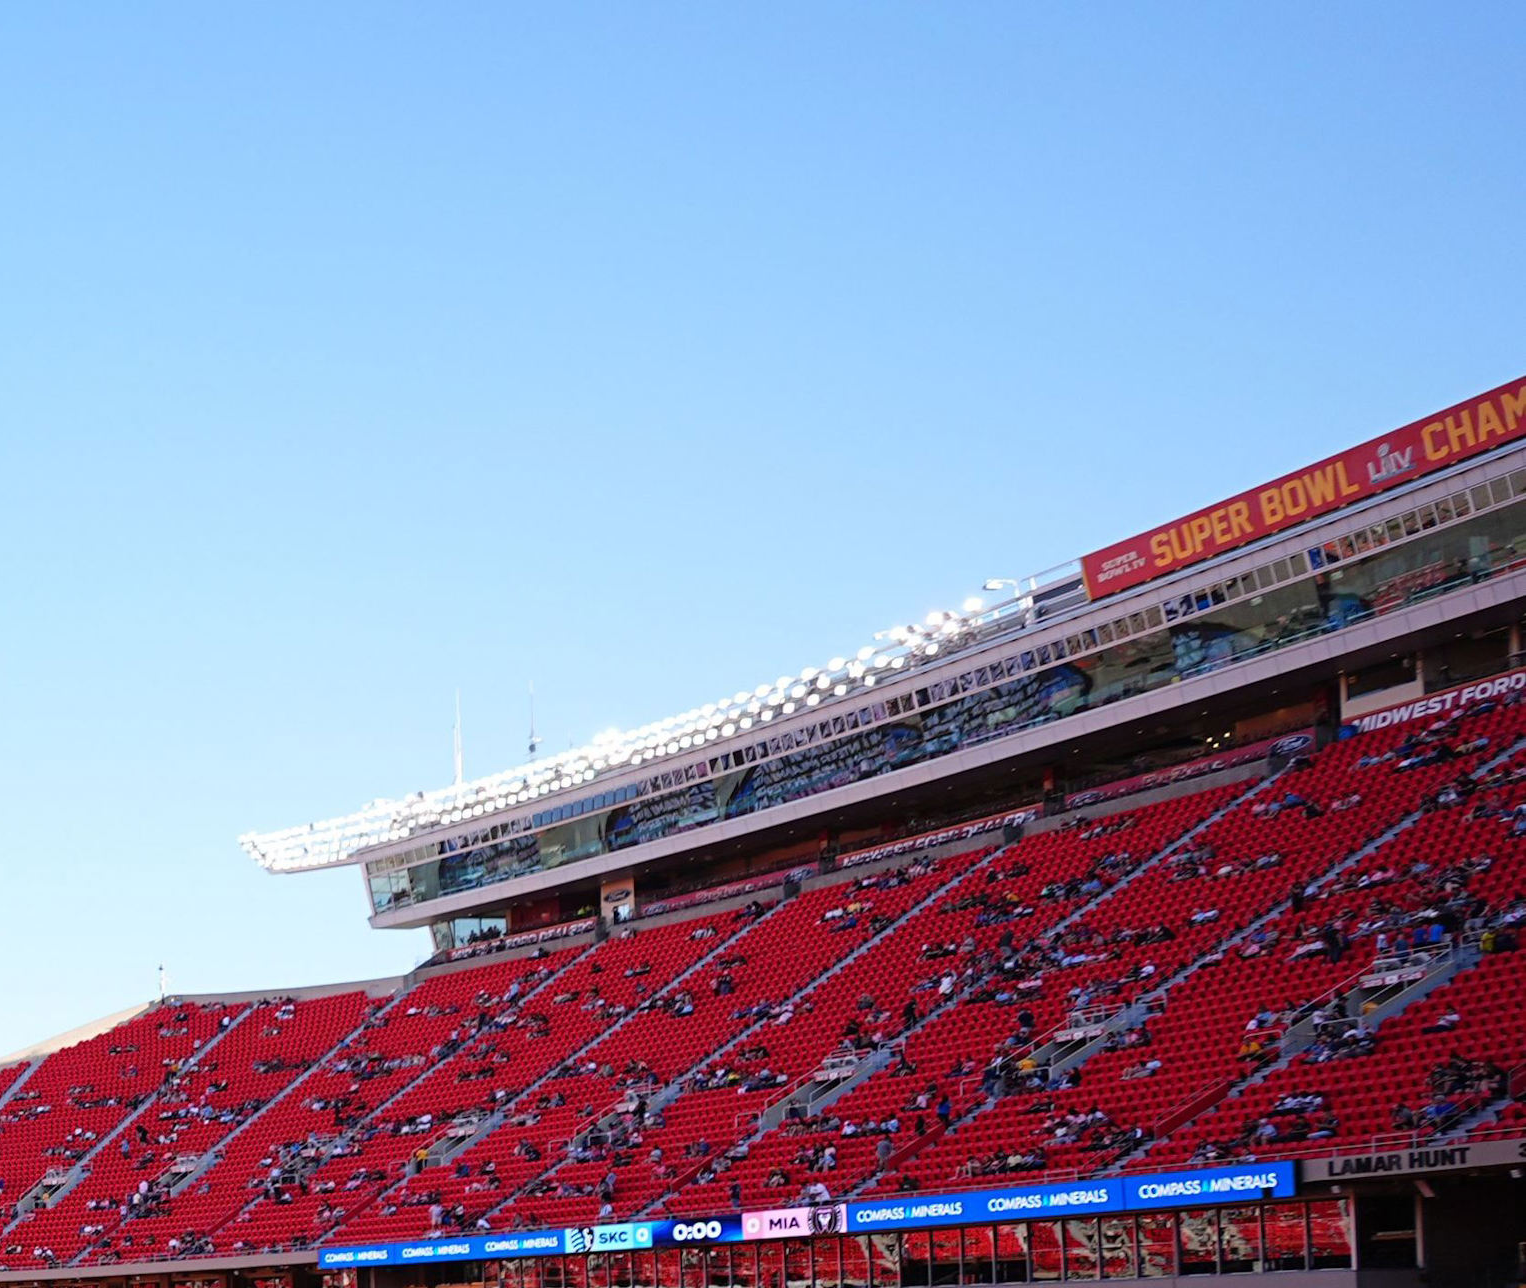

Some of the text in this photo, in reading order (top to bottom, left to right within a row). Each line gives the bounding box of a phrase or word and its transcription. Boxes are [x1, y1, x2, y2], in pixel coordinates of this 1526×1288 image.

[1150, 503, 1254, 568] SUPER
[1260, 461, 1359, 526] BOWL
[1351, 673, 1526, 733] MIDWEST FORD
[1328, 1147, 1470, 1176] LAMAR HUNT
[1138, 1172, 1278, 1198] COMPASS MINERALS
[857, 1202, 963, 1222] COMPASS MINERALS
[988, 1188, 1108, 1213] COMPASS MINERALS
[598, 1217, 801, 1244] SKC 0 0:00 0 MIA
